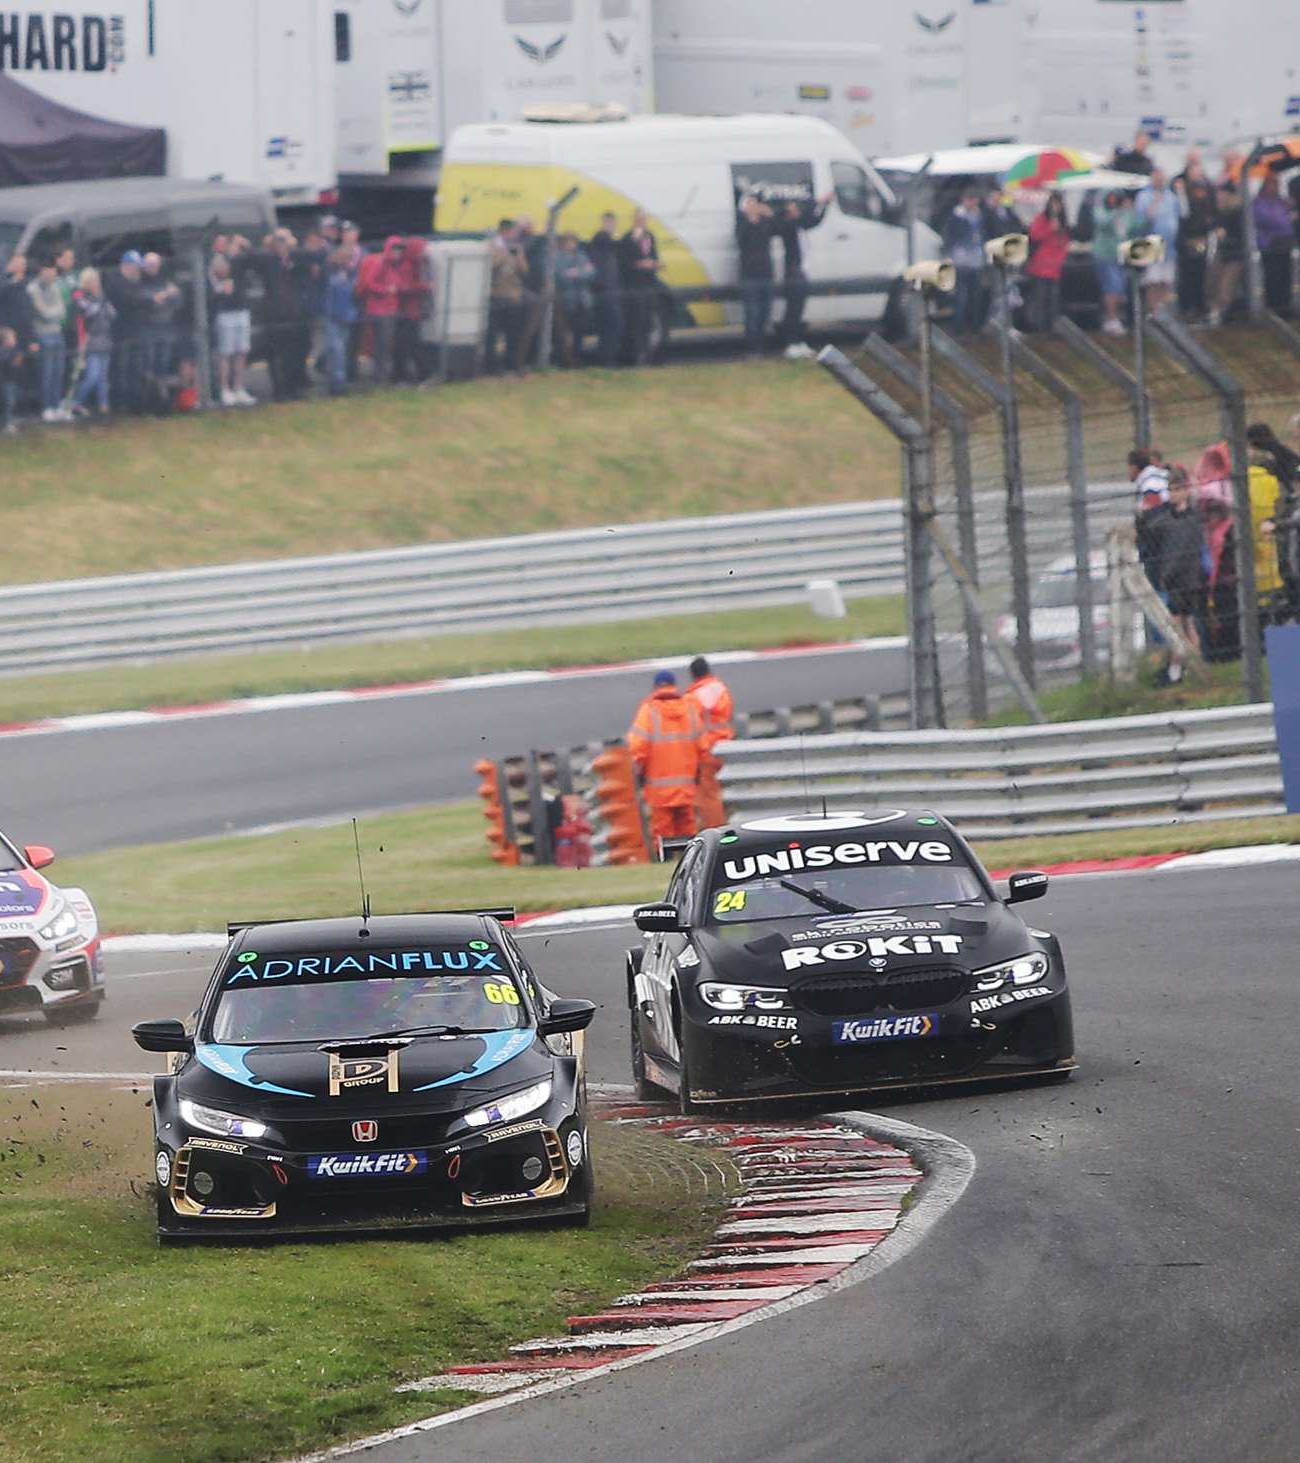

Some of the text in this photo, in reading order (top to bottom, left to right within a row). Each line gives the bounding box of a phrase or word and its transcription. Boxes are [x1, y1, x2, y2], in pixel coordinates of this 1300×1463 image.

[714, 890, 747, 913] 24
[483, 983, 520, 1005] 66
[970, 986, 1054, 1013] ABK BEER
[707, 1015, 798, 1030] ABK BEER
[343, 1077, 385, 1088] GROUP
